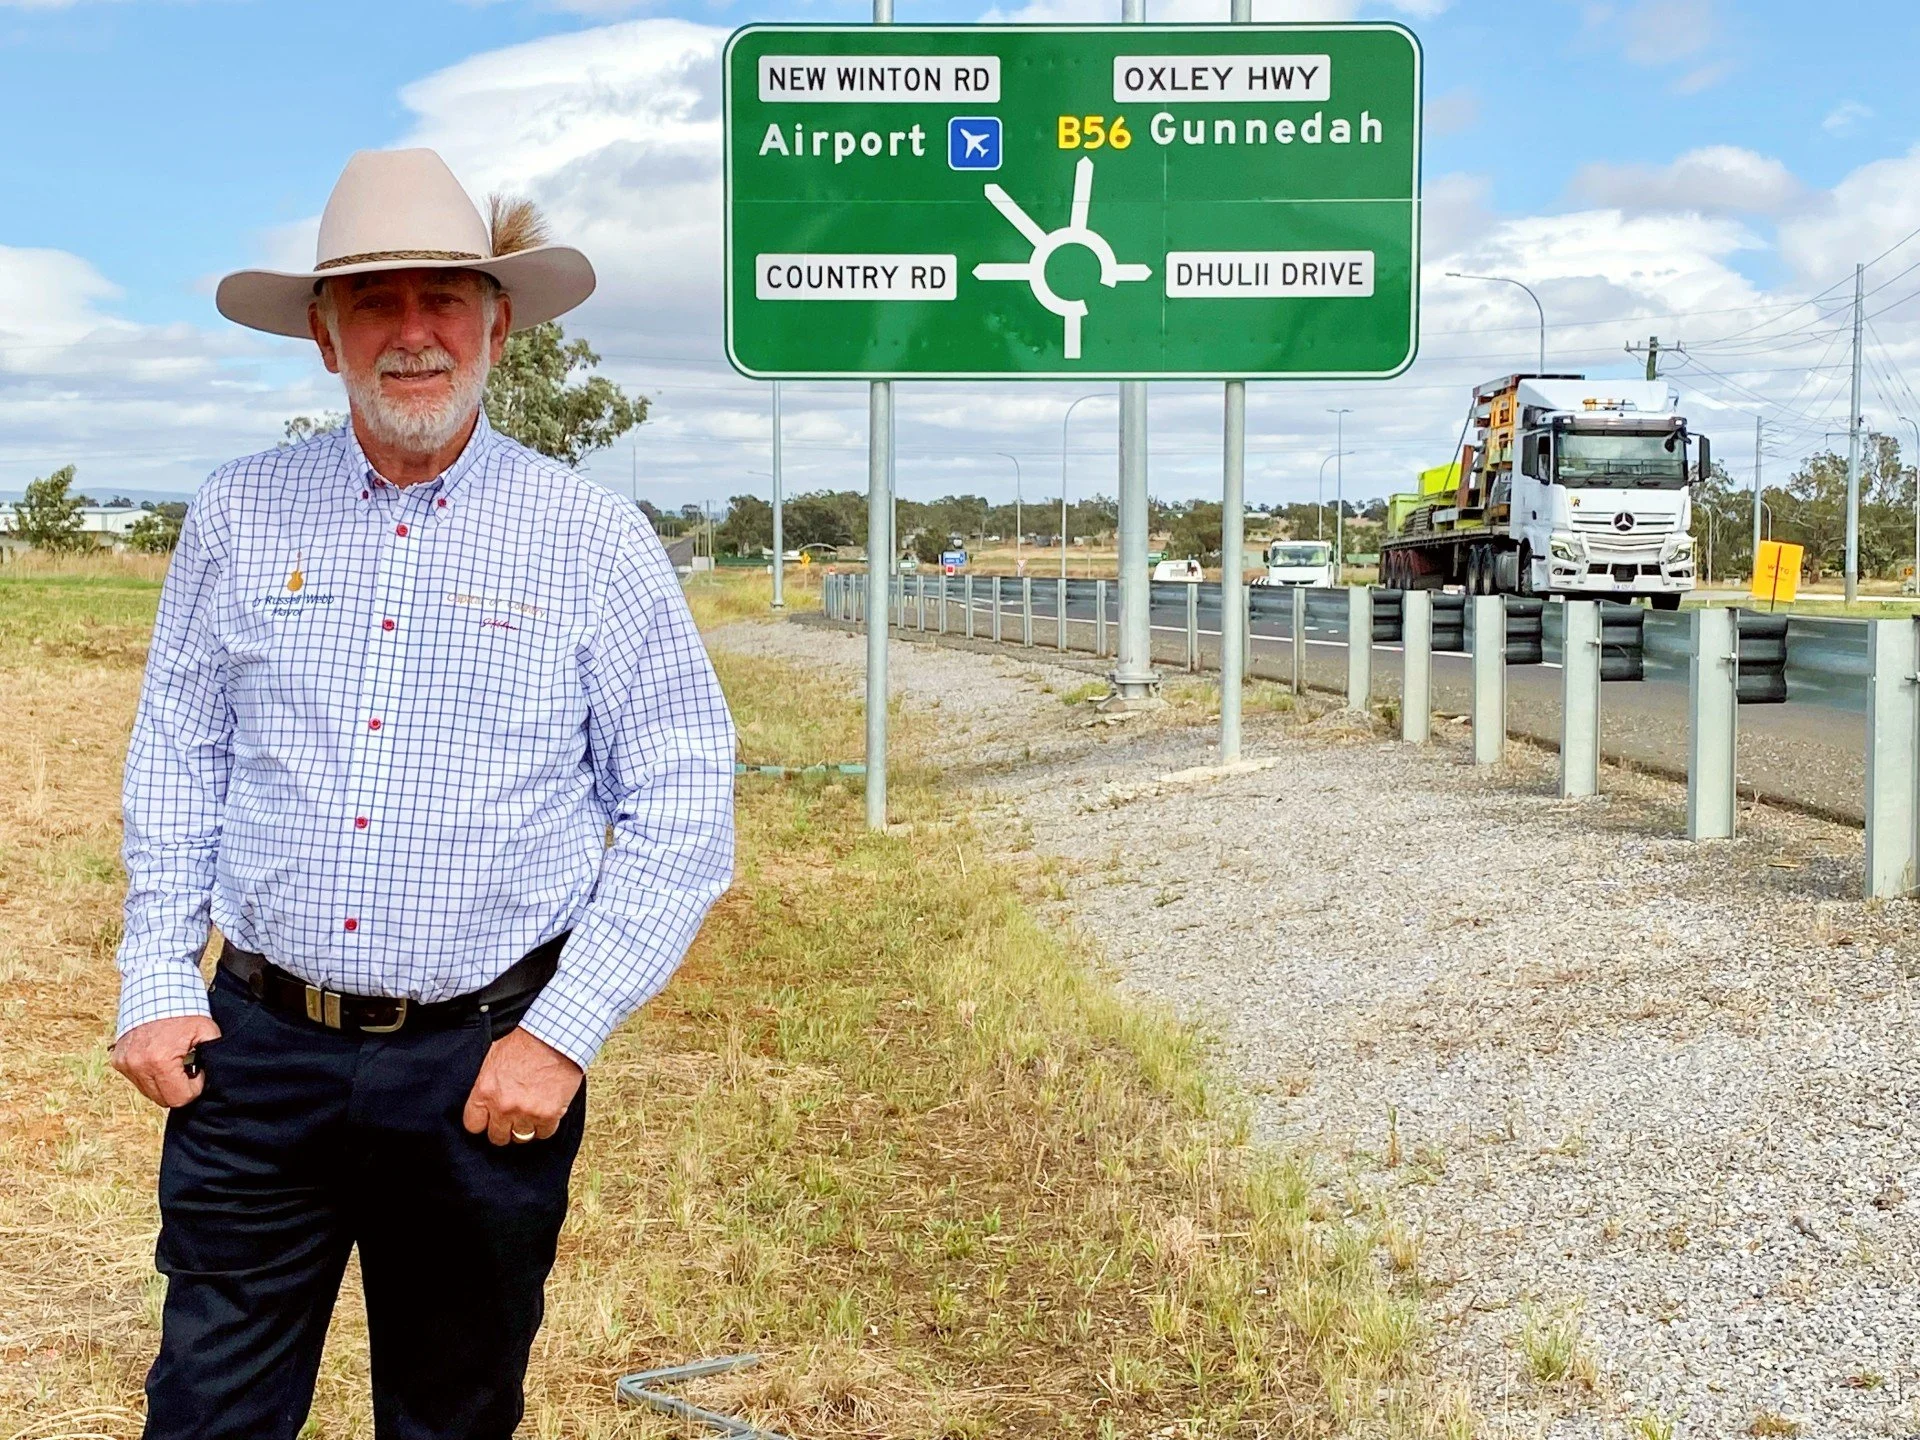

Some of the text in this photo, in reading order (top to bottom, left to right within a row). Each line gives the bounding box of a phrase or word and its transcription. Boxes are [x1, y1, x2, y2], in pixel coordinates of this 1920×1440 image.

[769, 67, 990, 91] NEW WINTON RD
[1124, 65, 1319, 92] OXLEY HWY
[1057, 110, 1383, 149] B56 Gunnedah
[758, 123, 926, 165] Airport
[767, 264, 946, 289] COUNTRY RD
[1176, 262, 1363, 286] DHULII DRIVE
[265, 594, 302, 605] Russell
[306, 593, 335, 605] Webb
[447, 593, 483, 605] Capital
[507, 601, 546, 619] Country
[271, 607, 304, 617] Mayor
